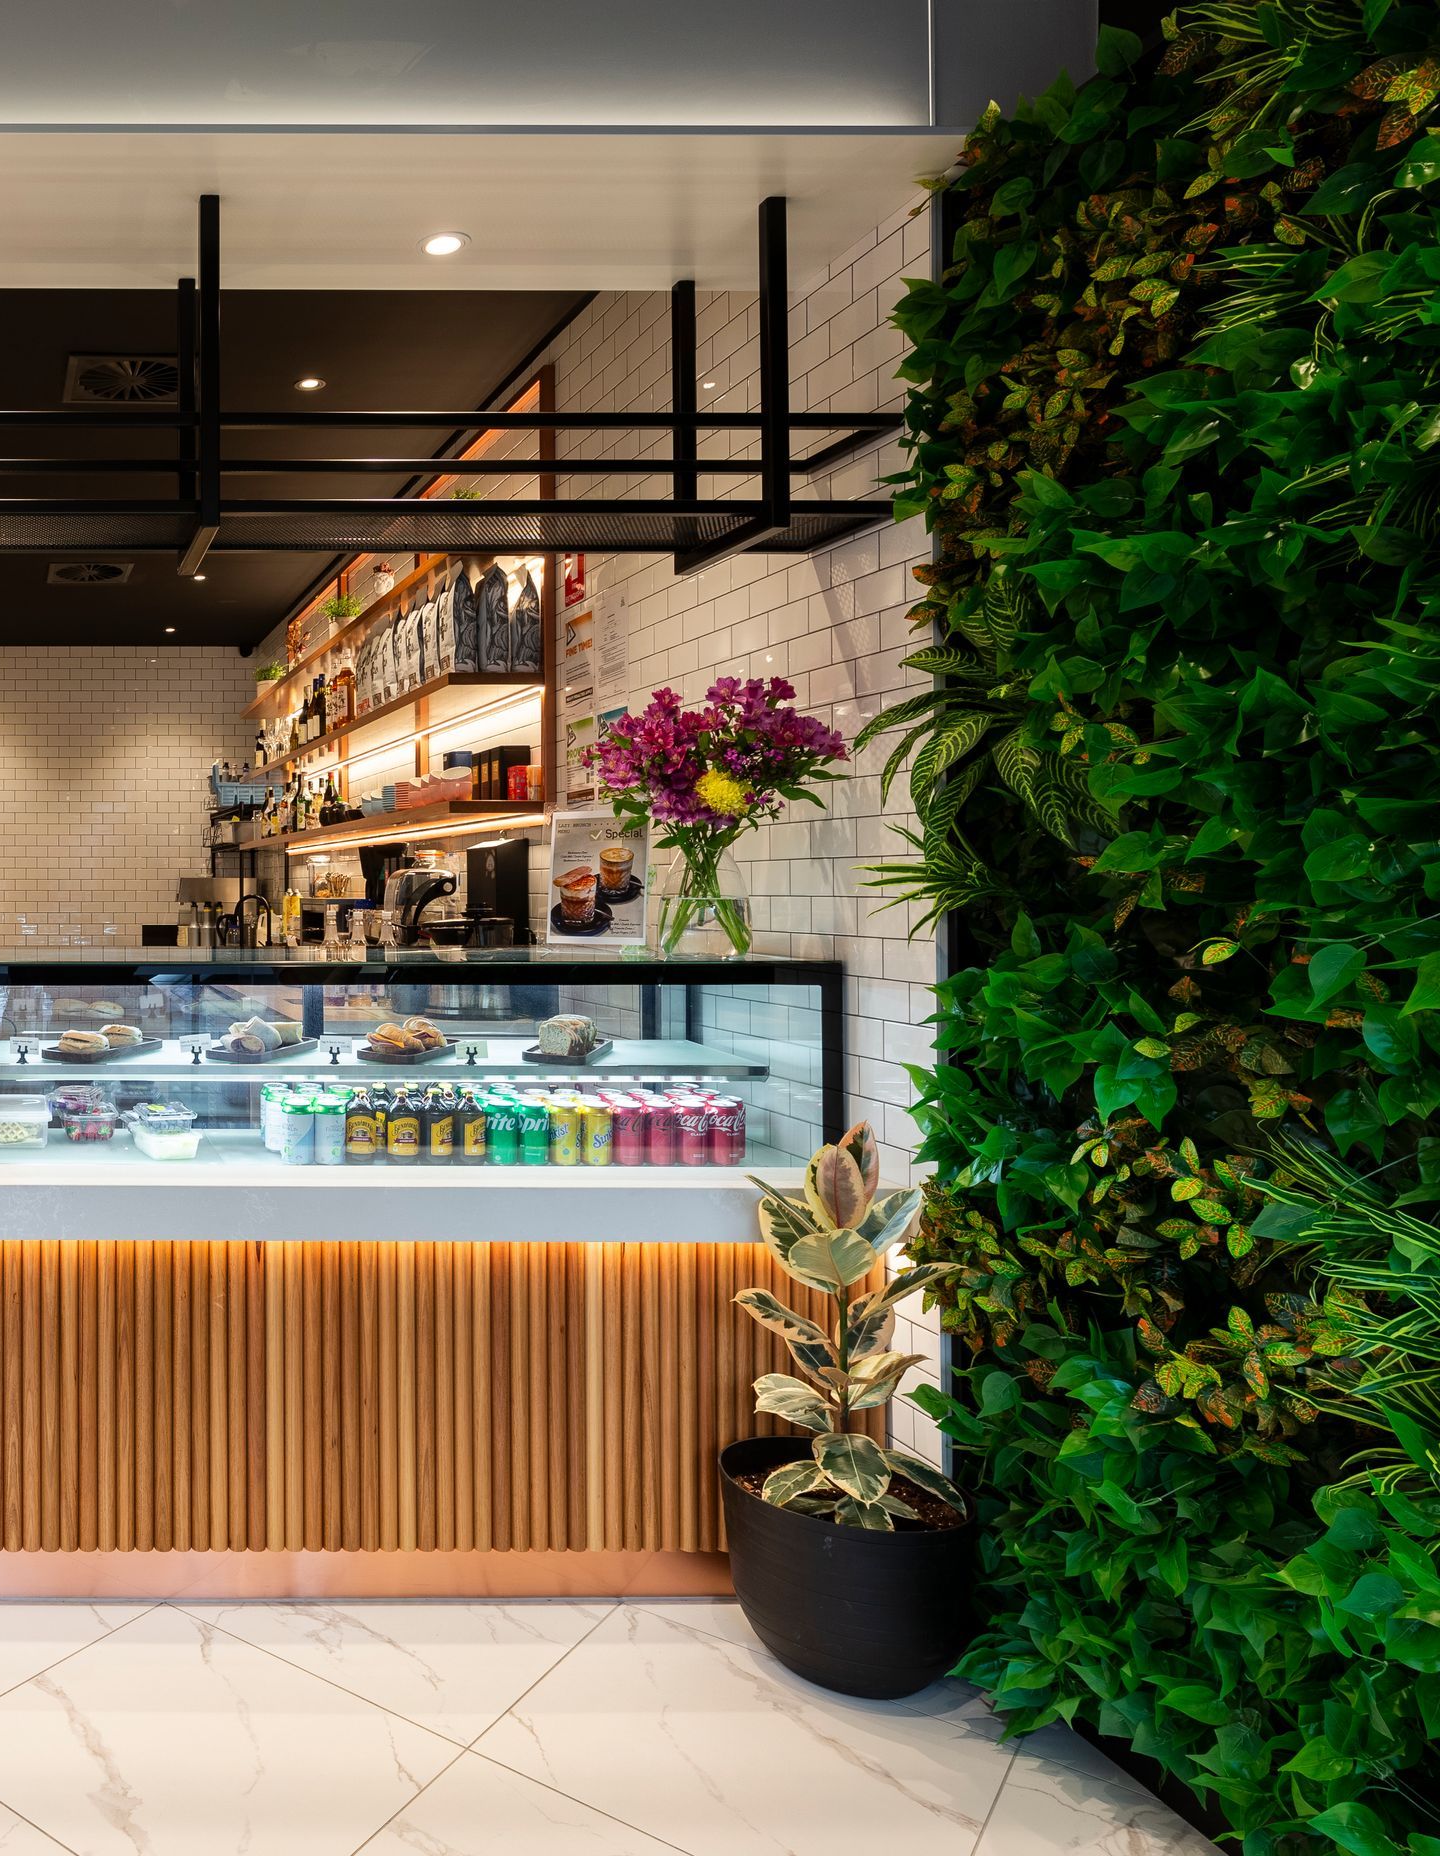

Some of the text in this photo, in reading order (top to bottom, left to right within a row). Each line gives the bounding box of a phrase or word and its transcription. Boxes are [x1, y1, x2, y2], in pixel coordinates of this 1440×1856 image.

[565, 637, 593, 658] FINE TIME!
[605, 828, 643, 840] Special
[486, 1113, 516, 1131] rite
[518, 1113, 550, 1133] Spri
